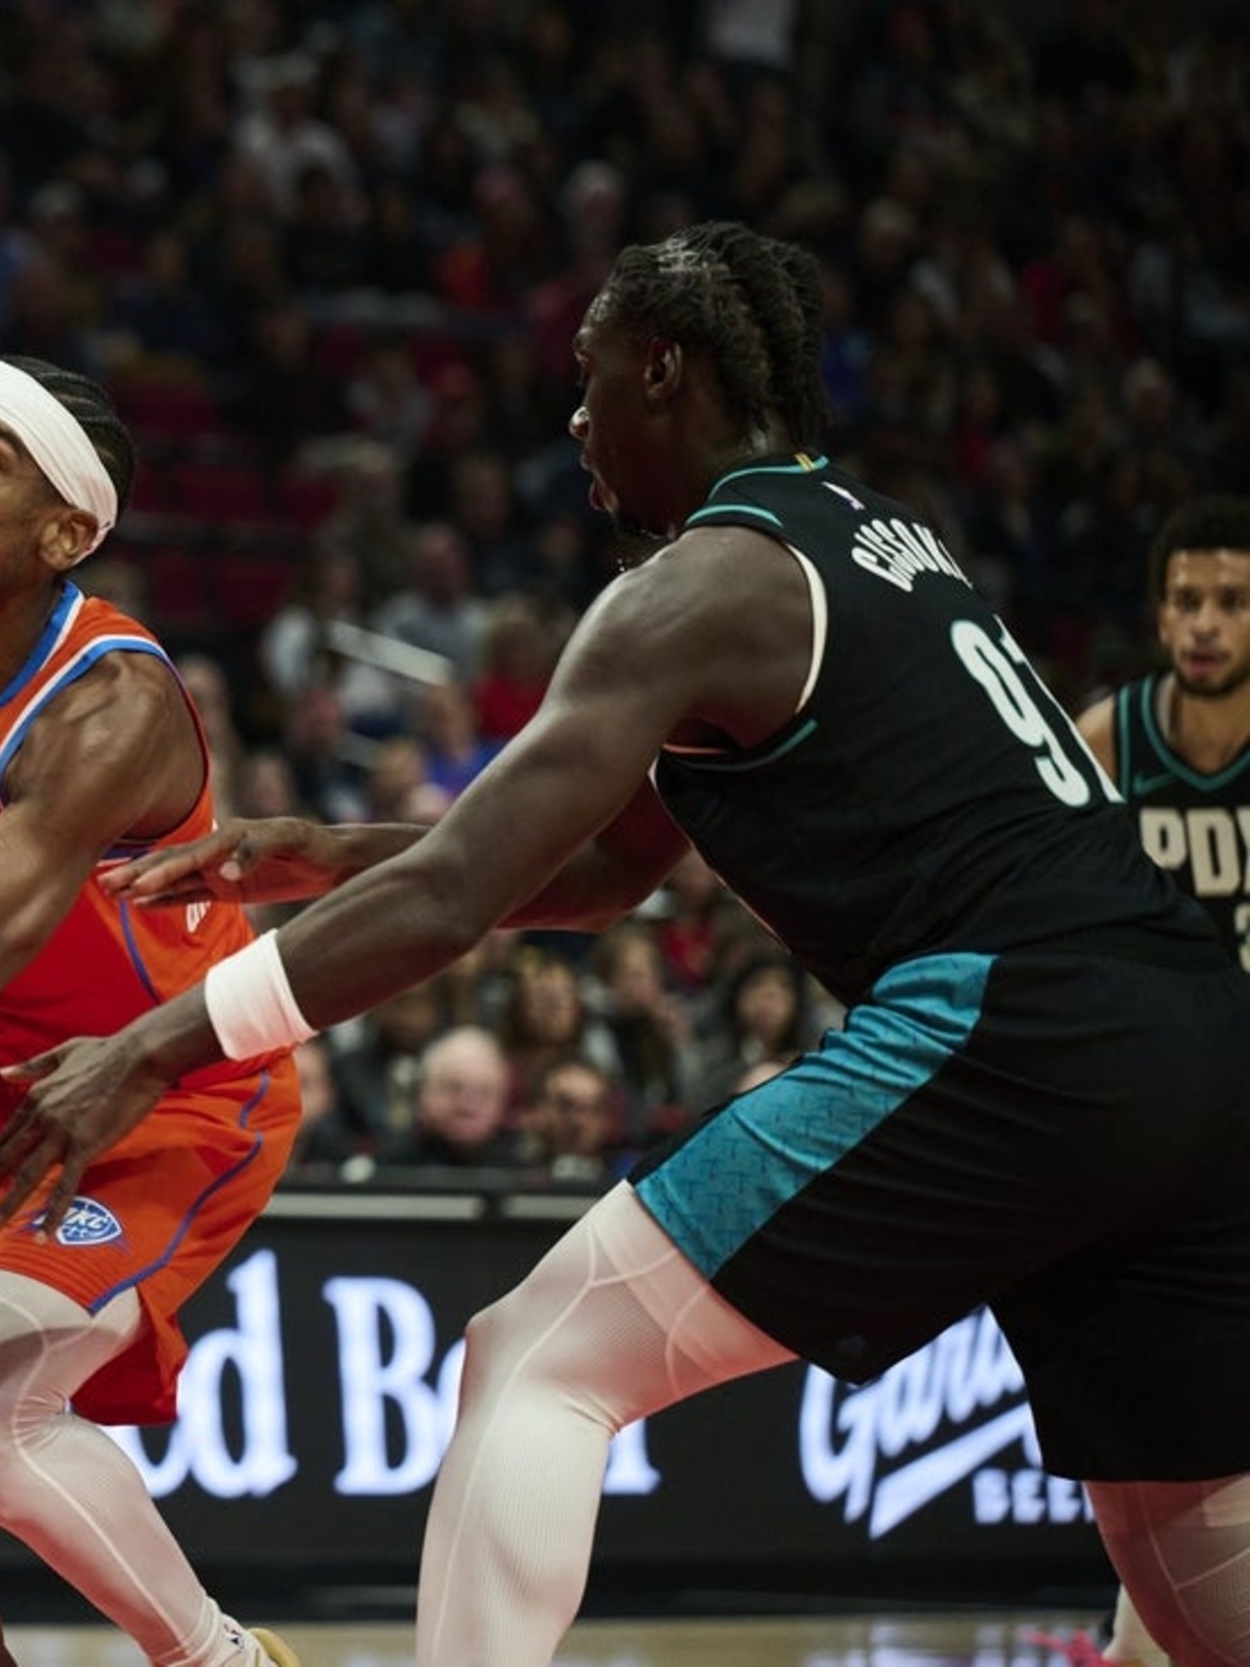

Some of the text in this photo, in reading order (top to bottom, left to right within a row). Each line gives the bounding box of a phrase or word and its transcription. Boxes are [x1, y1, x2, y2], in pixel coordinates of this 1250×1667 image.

[851, 518, 973, 593] CISSOK
[1139, 805, 1250, 898] PD
[972, 1467, 1095, 1524] BEE
